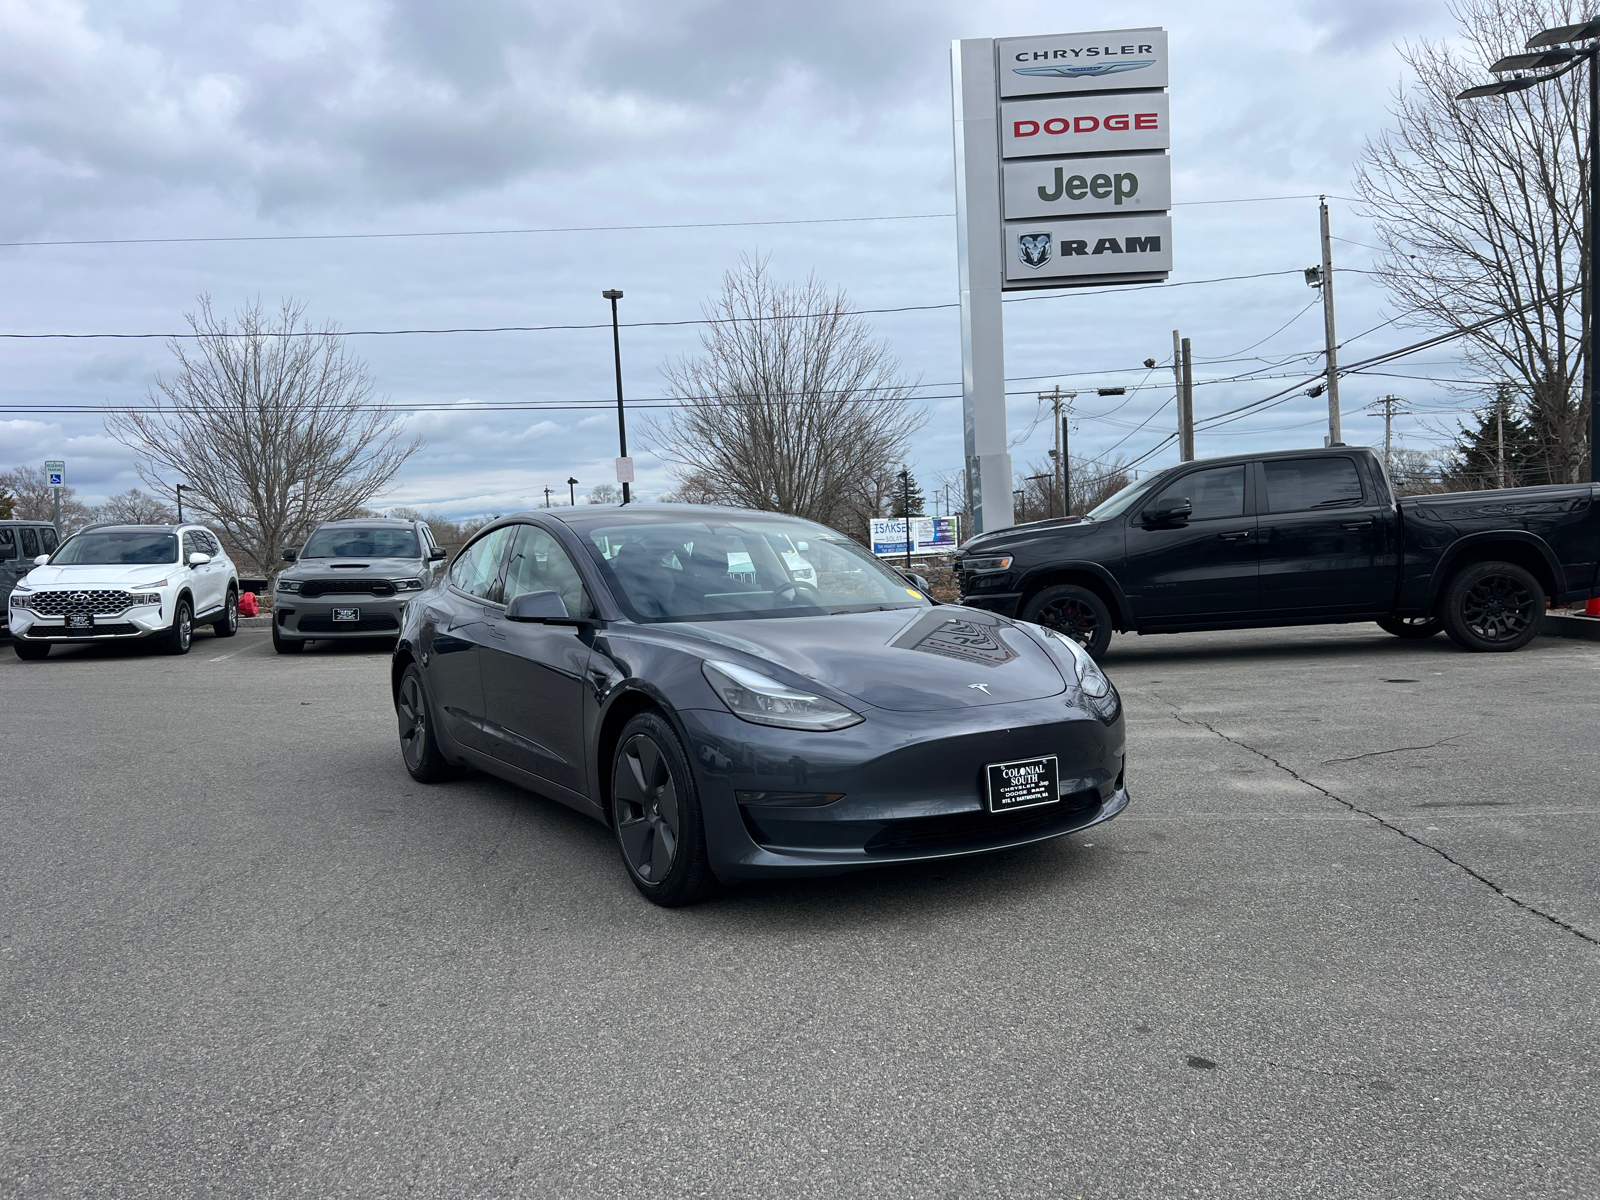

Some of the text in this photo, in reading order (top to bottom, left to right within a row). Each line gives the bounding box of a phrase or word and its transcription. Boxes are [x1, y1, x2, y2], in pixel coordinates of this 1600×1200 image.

[1015, 44, 1153, 62] CHRYSLER
[1013, 113, 1159, 138] DODGE
[1037, 167, 1139, 205] Jeep
[1060, 236, 1162, 257] RAM
[1003, 765, 1045, 778] COLONIAL
[1010, 774, 1038, 786] SOUTH
[1000, 784, 1035, 793] CHRYSLER
